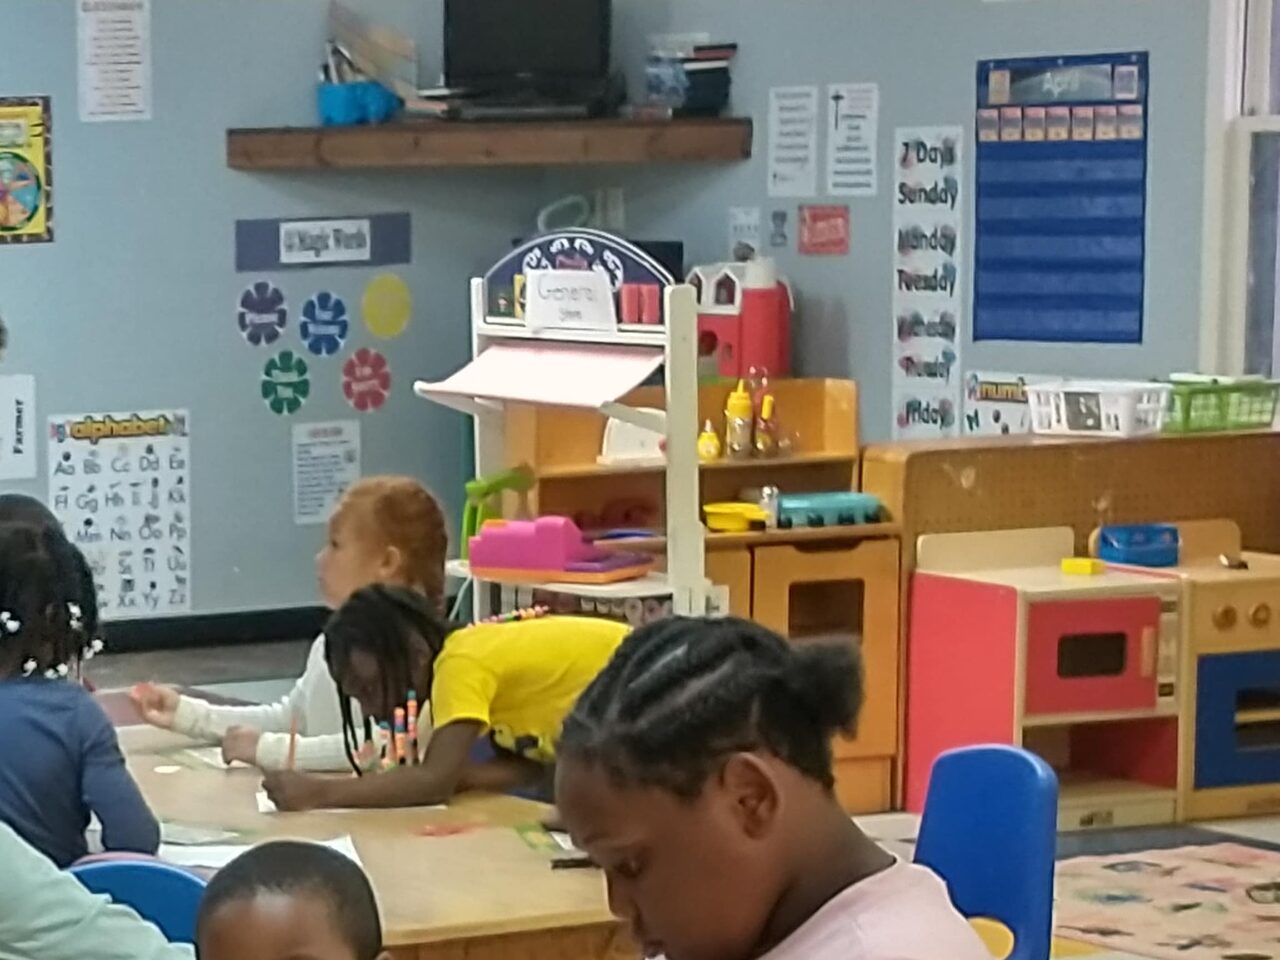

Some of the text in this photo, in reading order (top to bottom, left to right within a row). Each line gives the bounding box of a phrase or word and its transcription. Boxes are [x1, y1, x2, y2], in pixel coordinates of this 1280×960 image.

[898, 180, 956, 210] Sunday
[898, 227, 956, 257] Monday
[897, 267, 956, 297] Tuesday
[13, 399, 24, 454] Farmer
[71, 413, 171, 445] alphabet
[906, 400, 951, 429] Friday
